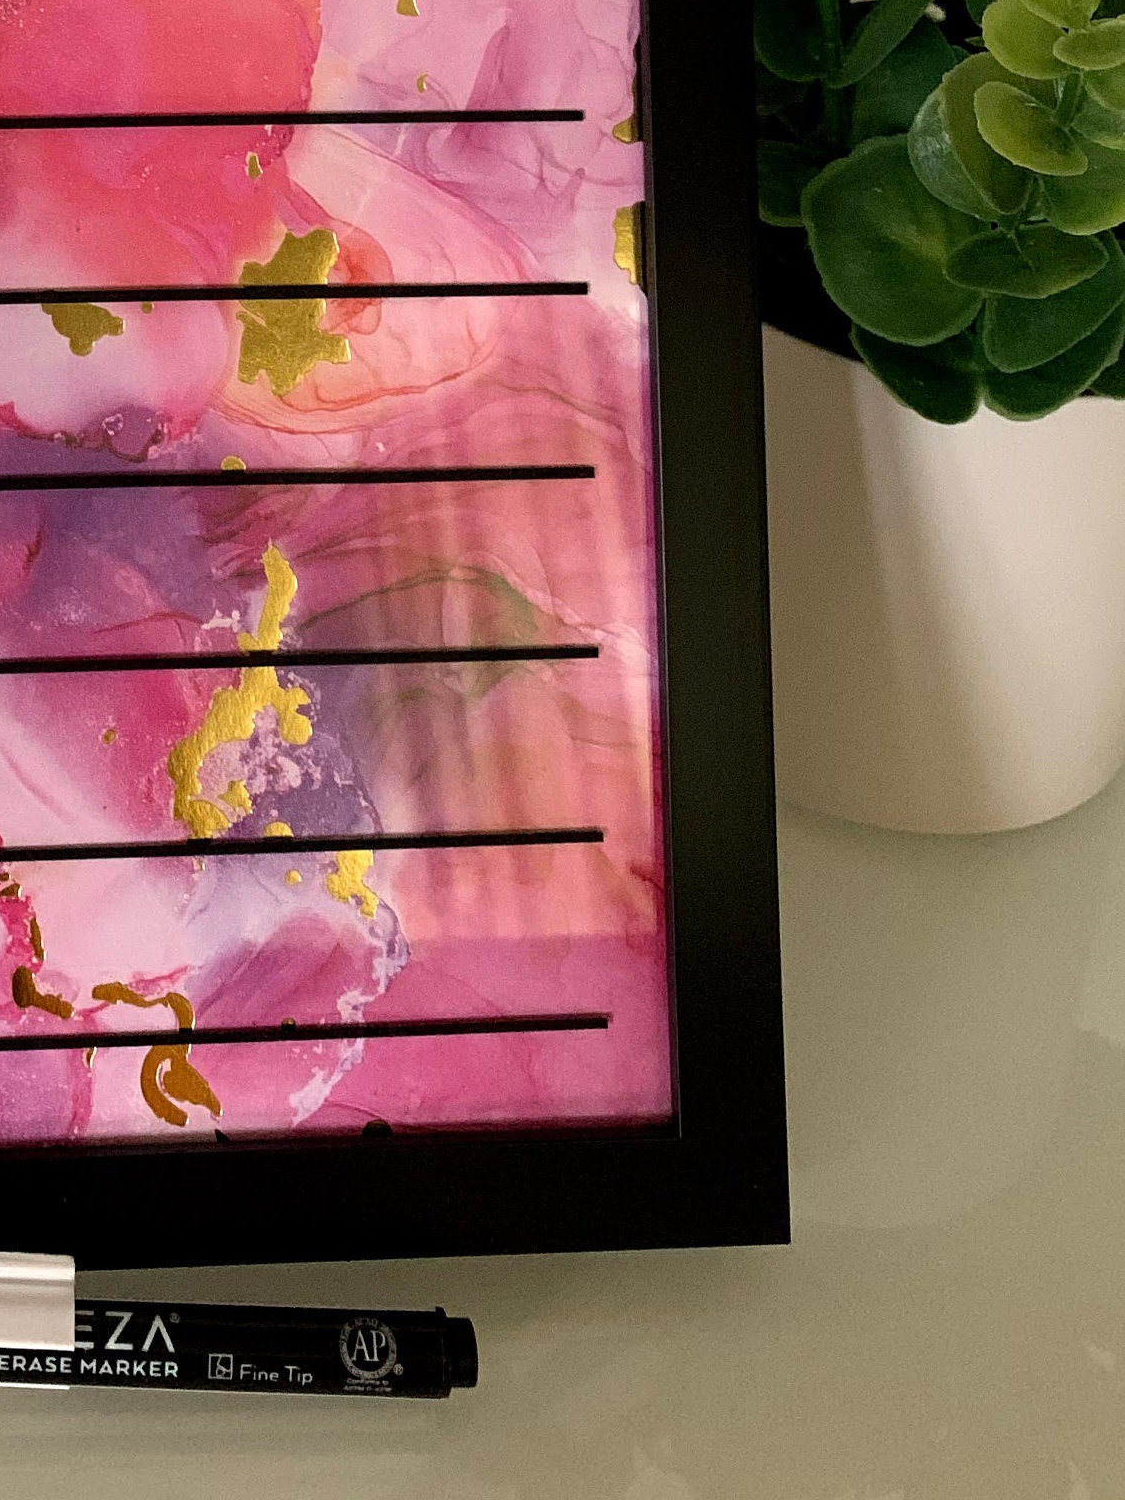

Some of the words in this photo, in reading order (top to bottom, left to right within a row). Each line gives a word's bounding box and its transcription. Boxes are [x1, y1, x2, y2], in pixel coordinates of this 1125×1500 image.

[352, 1330, 387, 1362] AP
[80, 1359, 179, 1378] MARKER
[240, 1364, 279, 1382] Fine
[284, 1366, 313, 1386] Tip
